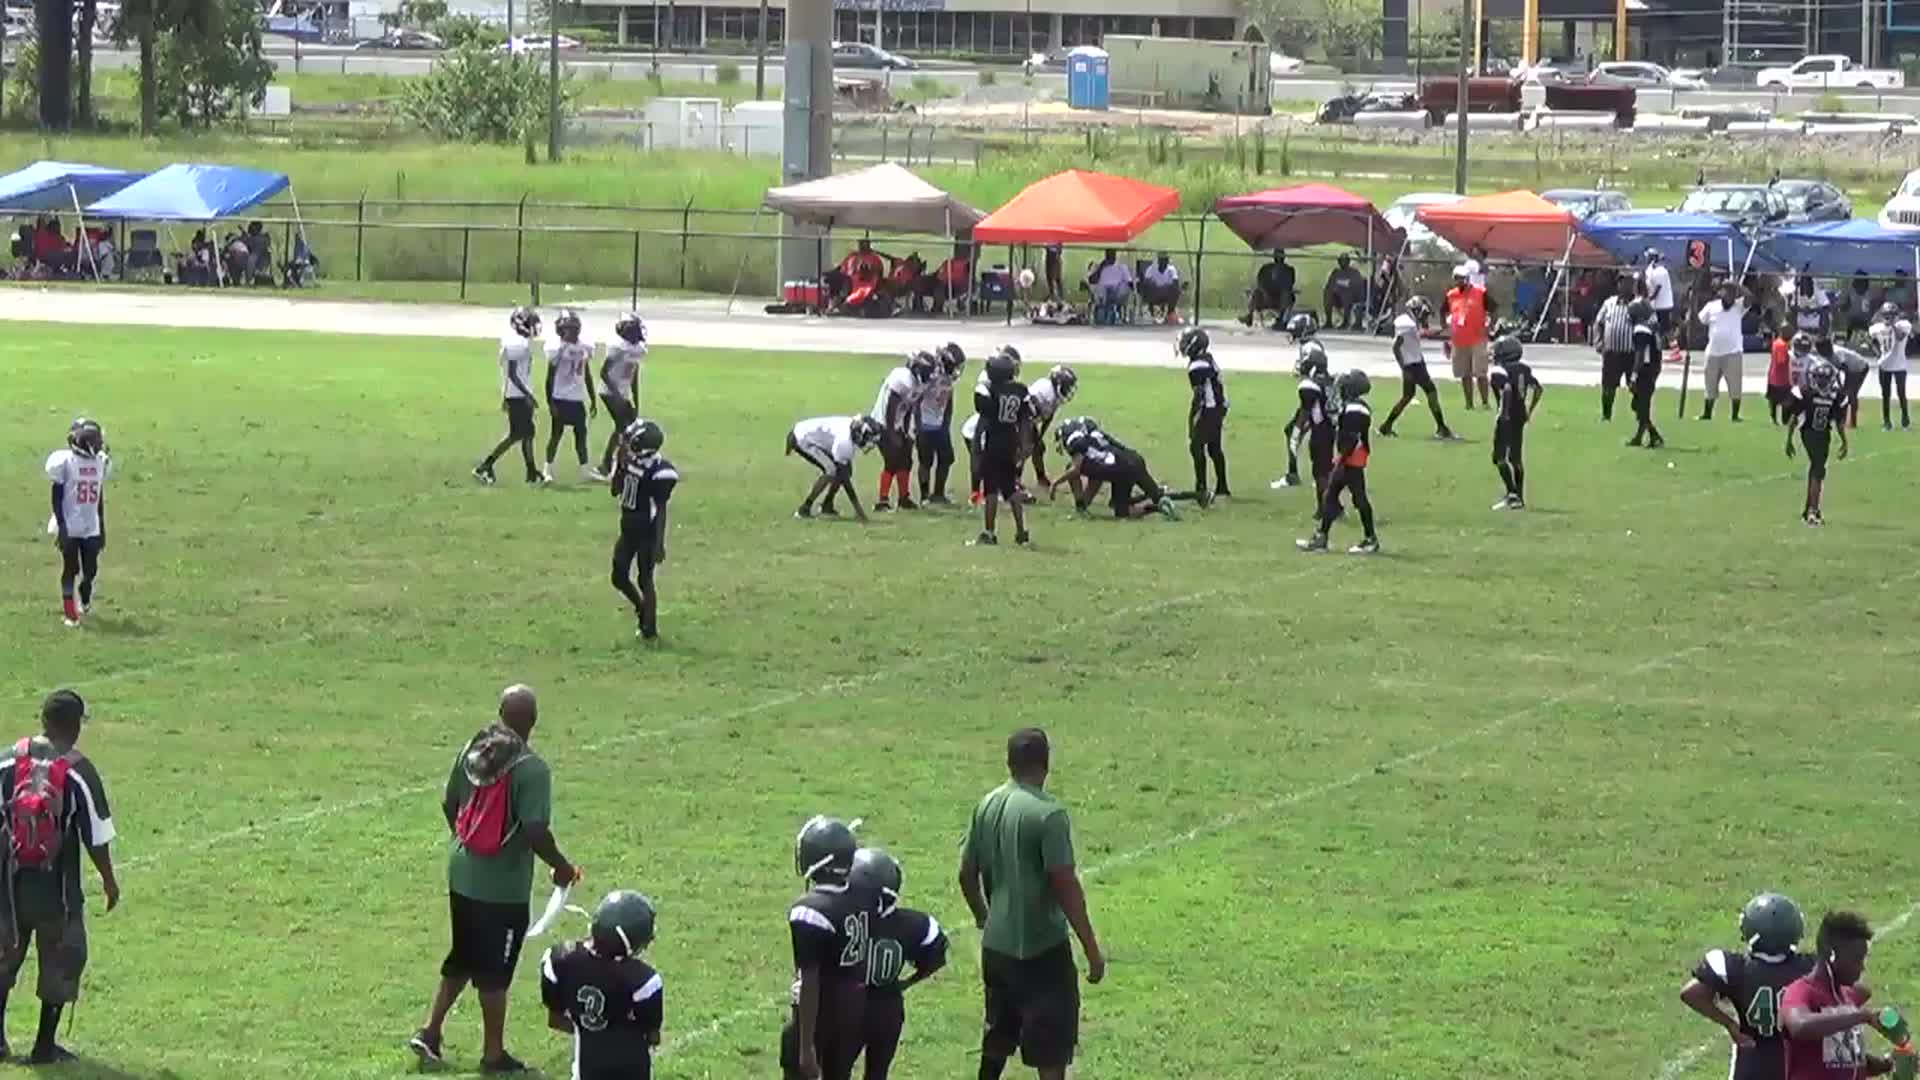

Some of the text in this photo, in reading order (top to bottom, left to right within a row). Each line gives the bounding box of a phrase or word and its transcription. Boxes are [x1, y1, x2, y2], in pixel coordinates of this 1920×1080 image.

[1689, 240, 1705, 269] 3
[999, 395, 1020, 423] 12
[840, 911, 868, 966] 21
[1745, 986, 1786, 1036] 4
